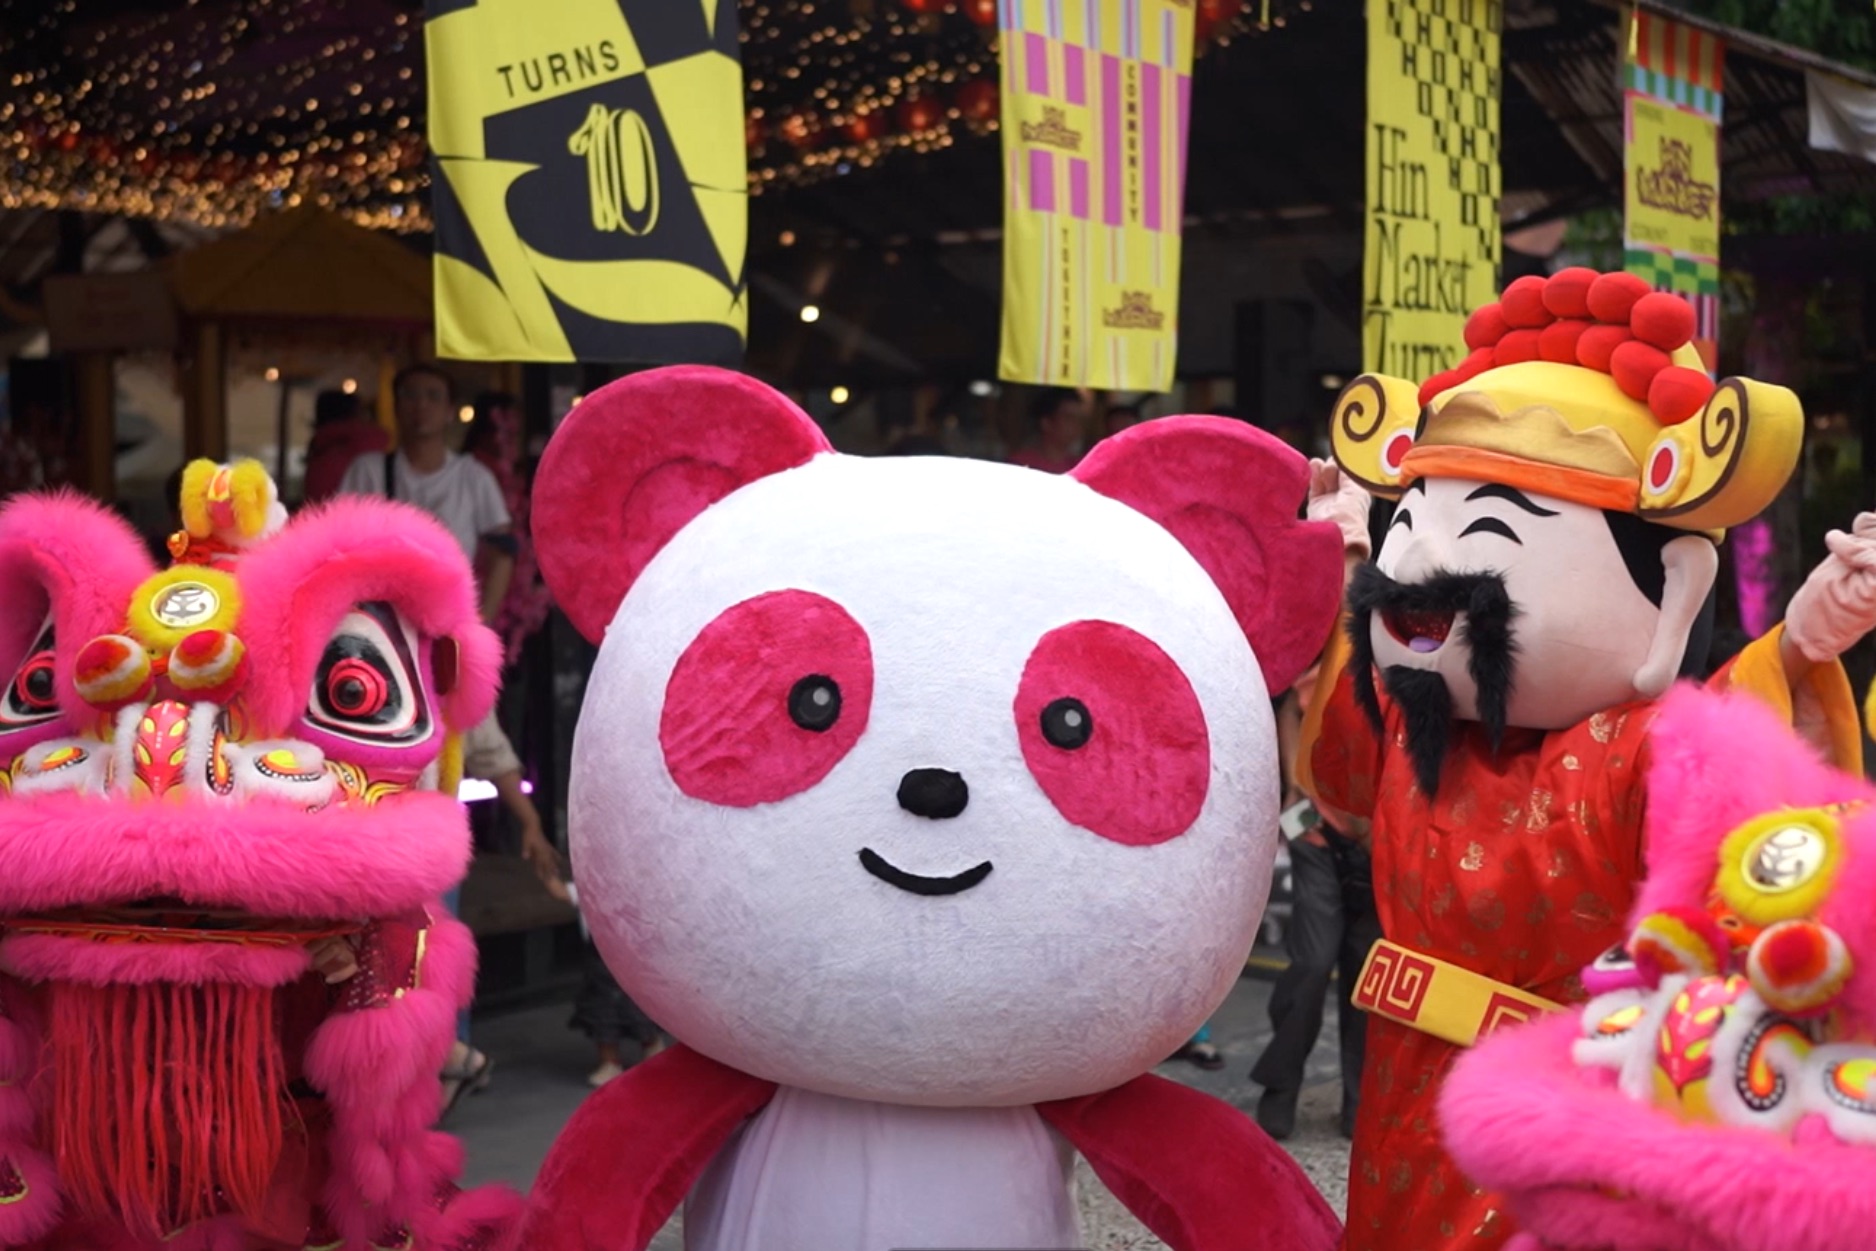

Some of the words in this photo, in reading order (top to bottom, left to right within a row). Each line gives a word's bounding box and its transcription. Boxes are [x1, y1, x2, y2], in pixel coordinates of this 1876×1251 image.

[496, 39, 620, 98] TURNS
[567, 103, 660, 236] 10
[1125, 64, 1139, 223] COMMUNITY
[1372, 123, 1429, 220] Hin
[1366, 217, 1474, 317] Market
